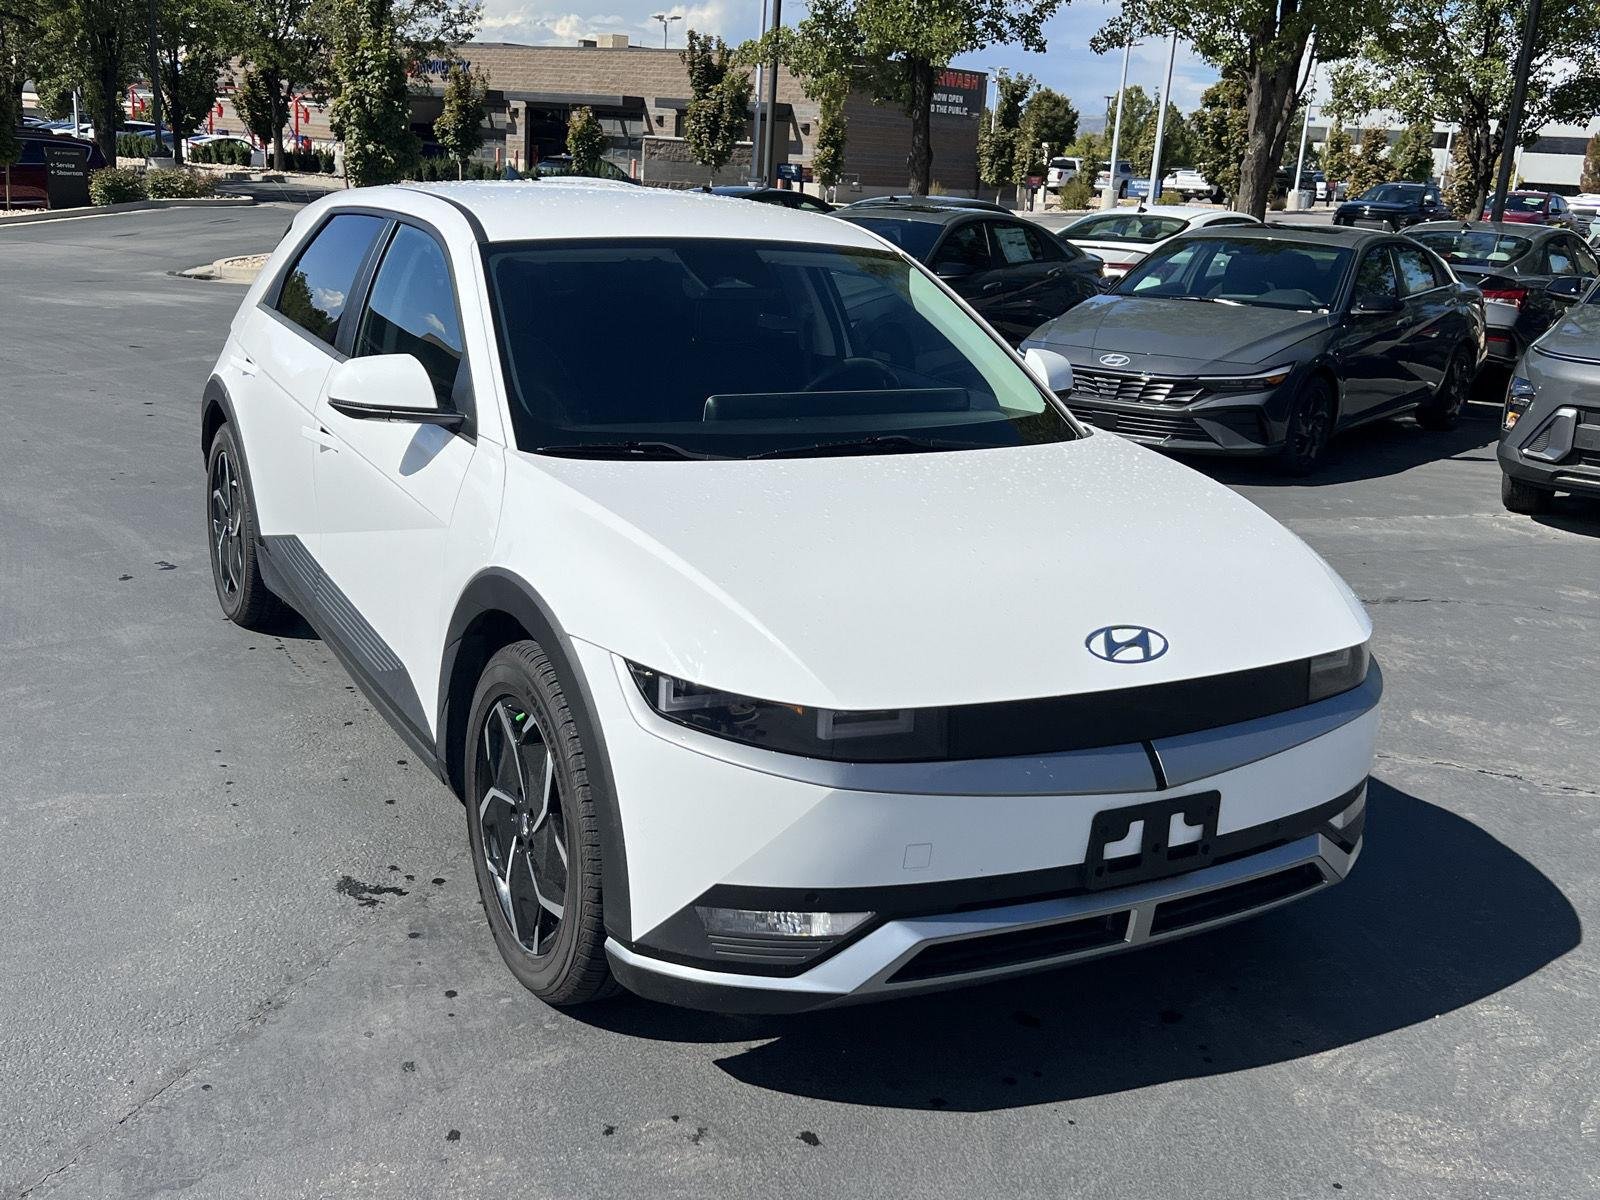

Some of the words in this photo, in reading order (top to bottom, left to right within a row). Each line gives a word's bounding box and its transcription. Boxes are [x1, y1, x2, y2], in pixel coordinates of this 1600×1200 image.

[933, 93, 948, 102] NOW
[948, 94, 963, 104] OPEN
[936, 104, 948, 114] THE
[948, 105, 968, 116] PUBLIC
